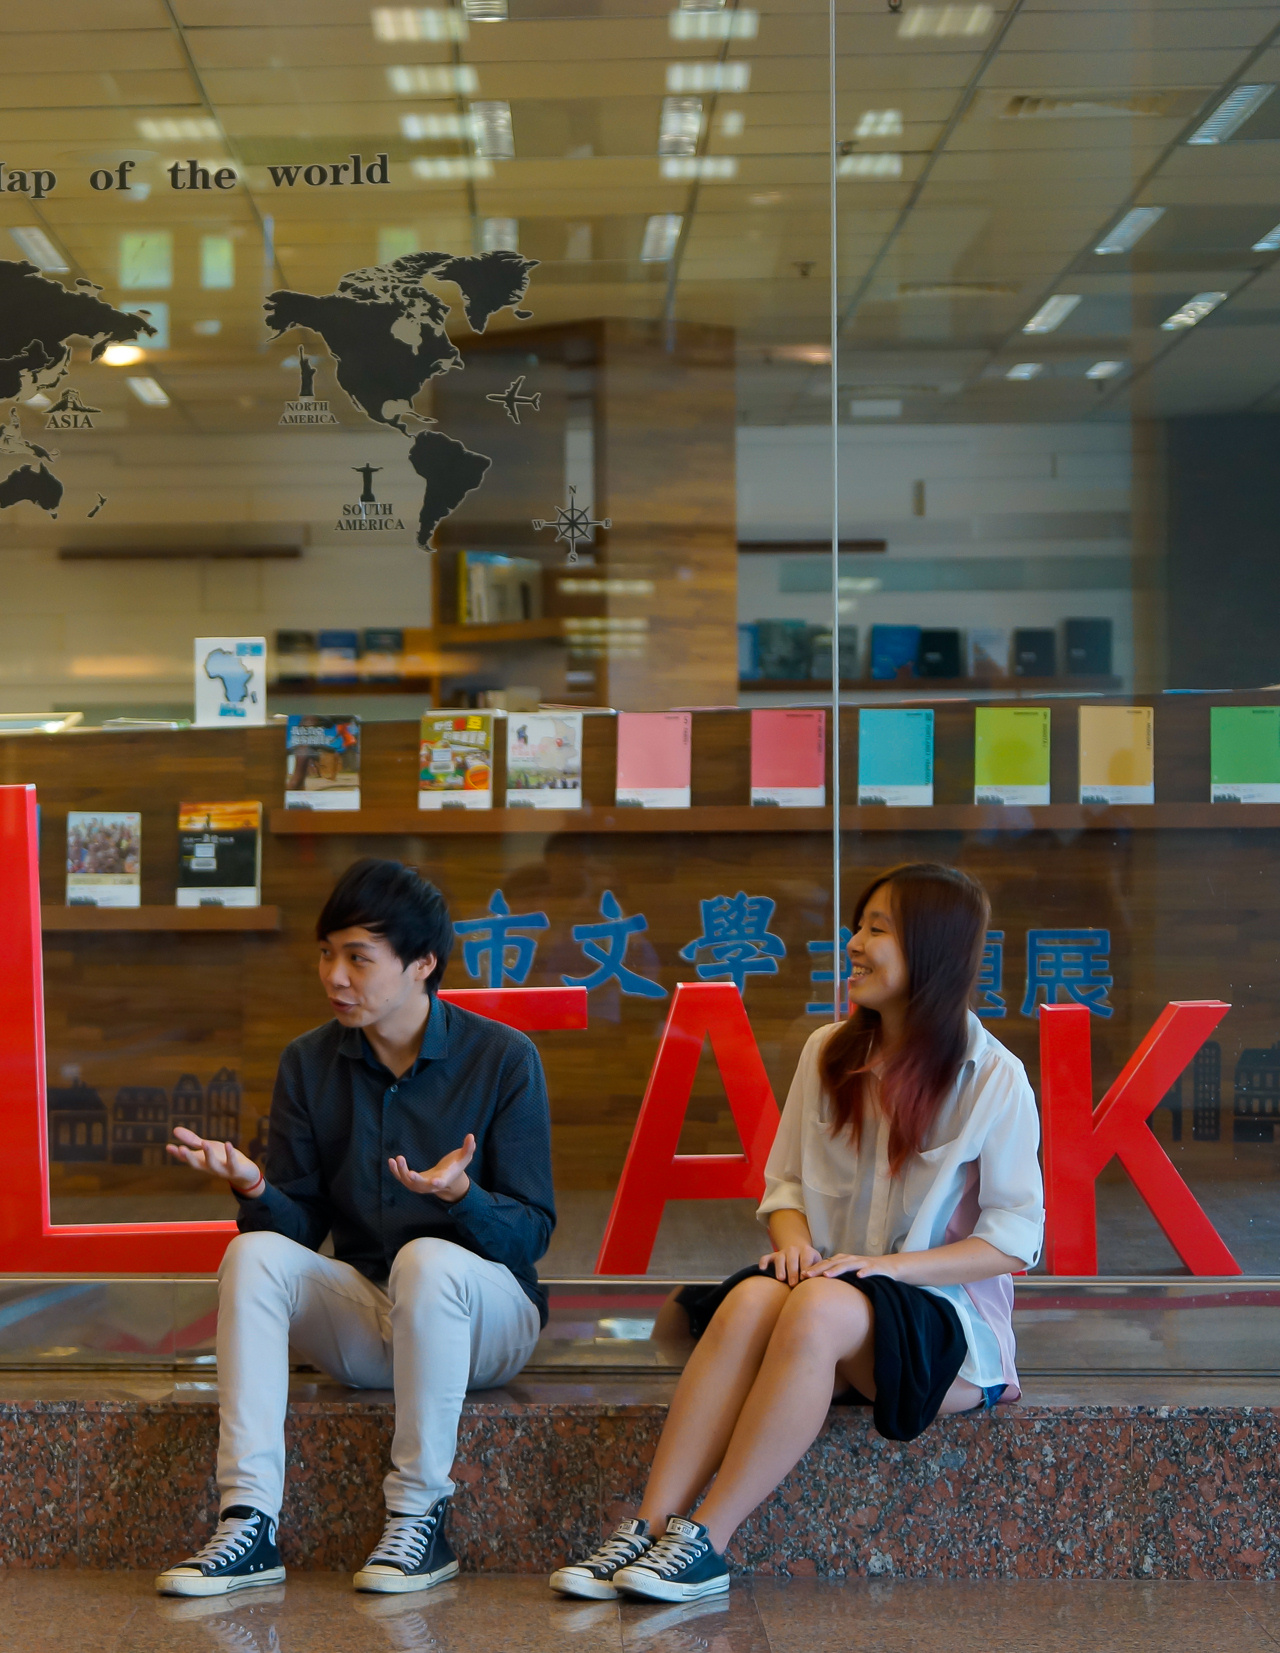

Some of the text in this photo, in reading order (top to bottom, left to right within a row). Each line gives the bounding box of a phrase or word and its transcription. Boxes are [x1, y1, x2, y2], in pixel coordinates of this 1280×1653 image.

[89, 160, 136, 191] of
[167, 158, 237, 190] the
[268, 153, 391, 187] world
[286, 401, 329, 412] NORTH
[46, 414, 94, 429] ASIA
[279, 414, 338, 424] AMERICA
[568, 485, 577, 495] N
[342, 503, 394, 516] SOUTH
[334, 518, 406, 531] AMERICA
[533, 520, 544, 529] W
[569, 553, 577, 563] S
